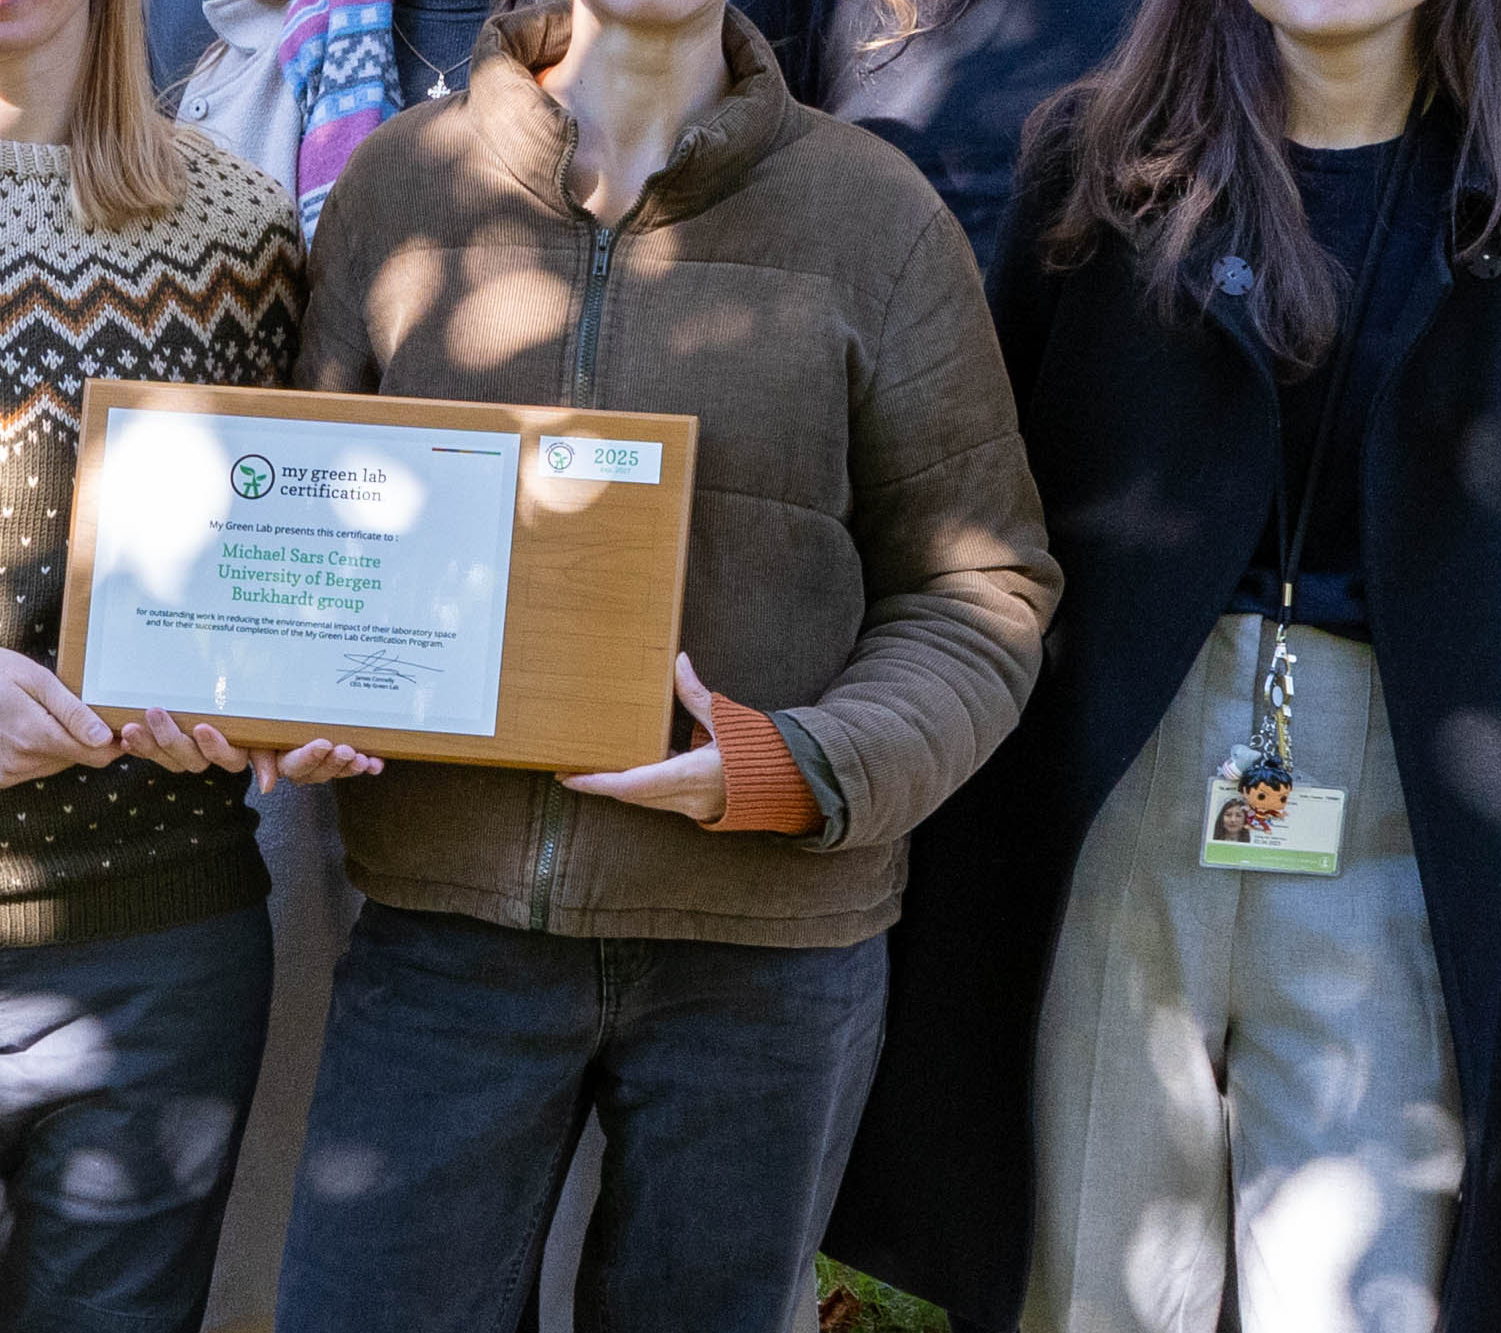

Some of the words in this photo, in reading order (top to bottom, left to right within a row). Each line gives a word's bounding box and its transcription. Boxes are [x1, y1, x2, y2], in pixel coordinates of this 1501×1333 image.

[594, 448, 639, 466] 2025
[281, 466, 310, 481] my
[310, 467, 358, 484] green
[363, 468, 387, 483] lab
[209, 521, 223, 532] My
[225, 522, 254, 532] Green
[256, 523, 273, 533] Lab
[274, 525, 315, 537] presents
[317, 527, 334, 538] this
[336, 530, 382, 542] certificate
[221, 542, 286, 562] Michael
[290, 548, 324, 564] Sars
[328, 550, 382, 569] Centre
[217, 563, 302, 587] University
[305, 570, 322, 585] of
[325, 571, 382, 592] Bergen
[231, 585, 314, 606] Burkhardt
[317, 596, 364, 613] group
[136, 607, 148, 616] for
[149, 608, 196, 620] outstanding
[196, 612, 215, 621] work
[217, 613, 225, 622] in
[226, 615, 260, 626] reducing
[261, 617, 274, 625] the
[275, 618, 332, 630] environmental
[333, 623, 361, 633] impact
[362, 624, 371, 632] of
[371, 625, 390, 634] their
[391, 626, 433, 638] laboratory
[434, 630, 457, 640] space
[146, 618, 161, 627] and
[162, 619, 174, 627] for
[175, 620, 194, 629] their
[195, 622, 235, 632] successful
[235, 625, 279, 636] completion
[281, 627, 290, 636] of
[291, 629, 304, 637] the
[305, 630, 317, 640] My
[318, 631, 343, 641] Green
[344, 633, 358, 642] Lab
[360, 634, 408, 646] Certification
